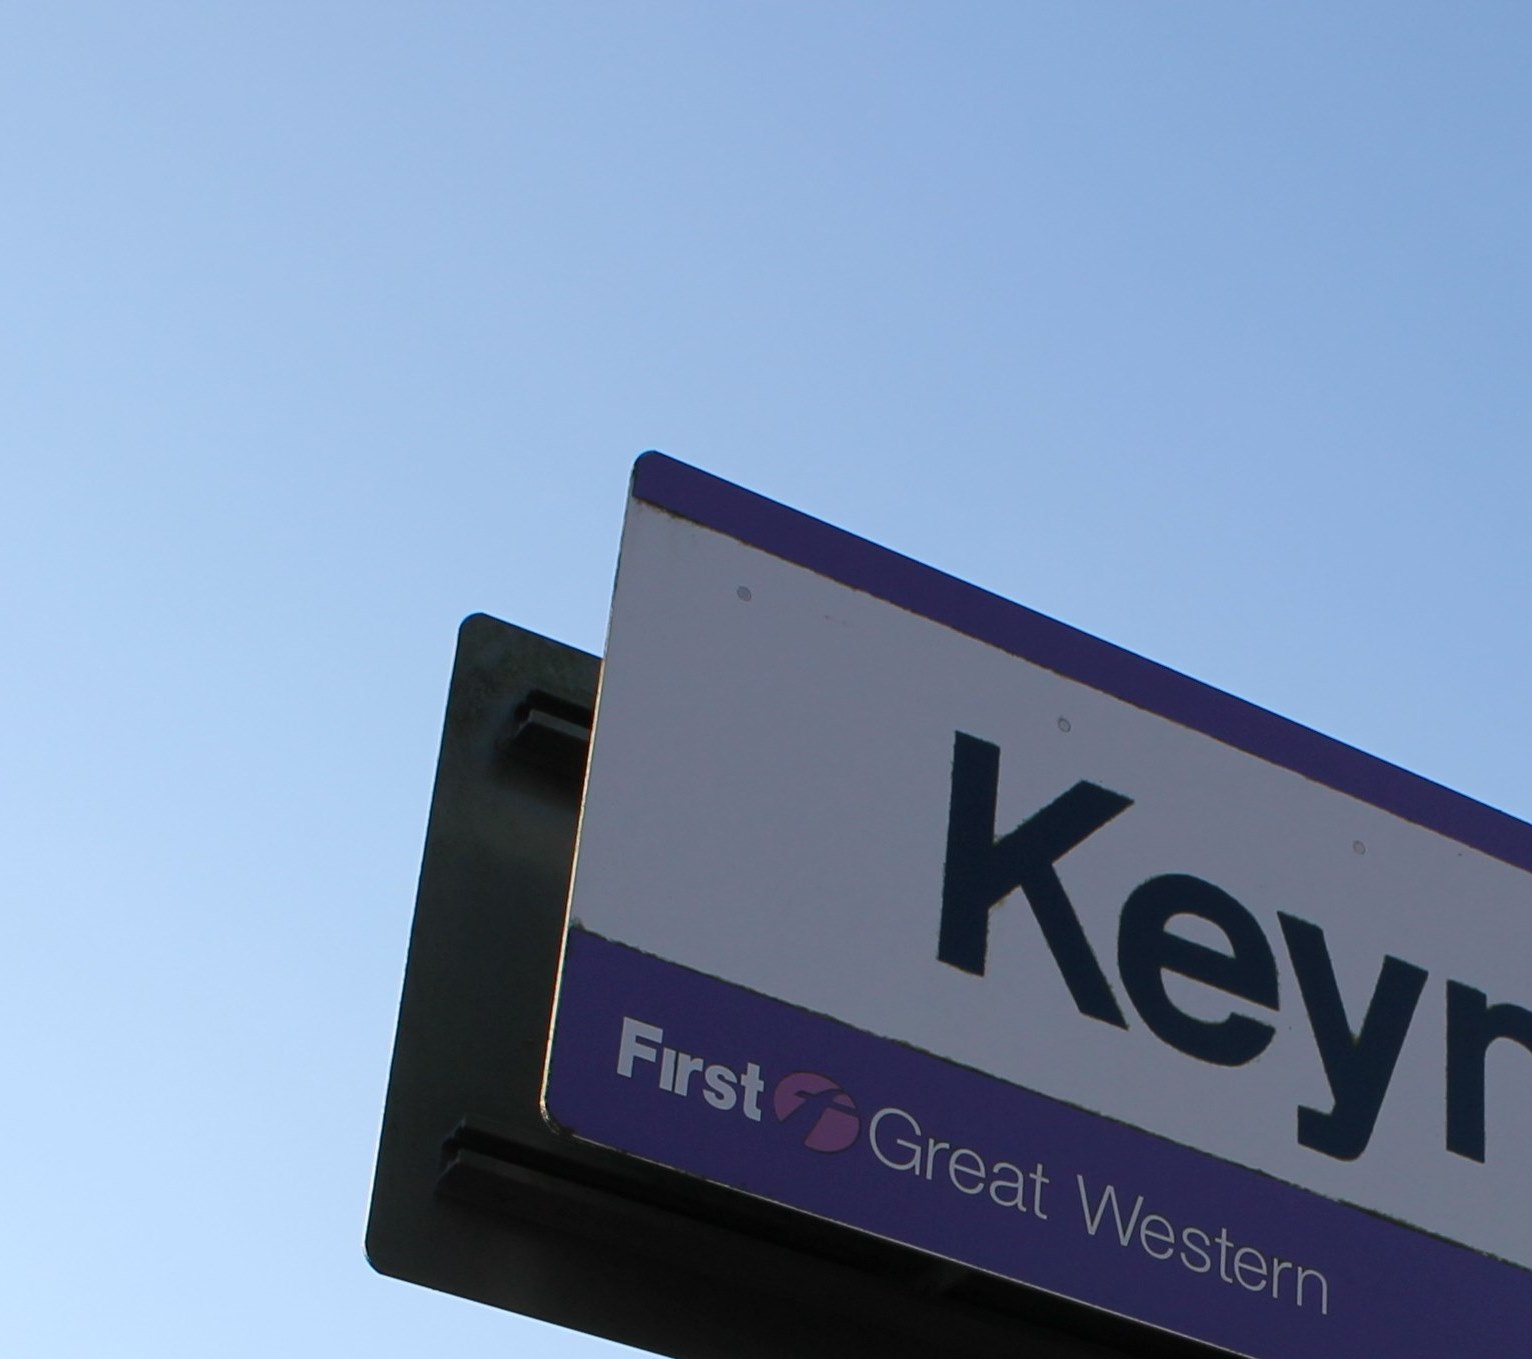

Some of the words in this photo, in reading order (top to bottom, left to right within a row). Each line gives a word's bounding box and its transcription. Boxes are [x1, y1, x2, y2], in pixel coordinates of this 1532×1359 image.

[616, 1015, 765, 1122] First
[868, 1107, 1049, 1220] Great
[1076, 1174, 1330, 1316] Western
